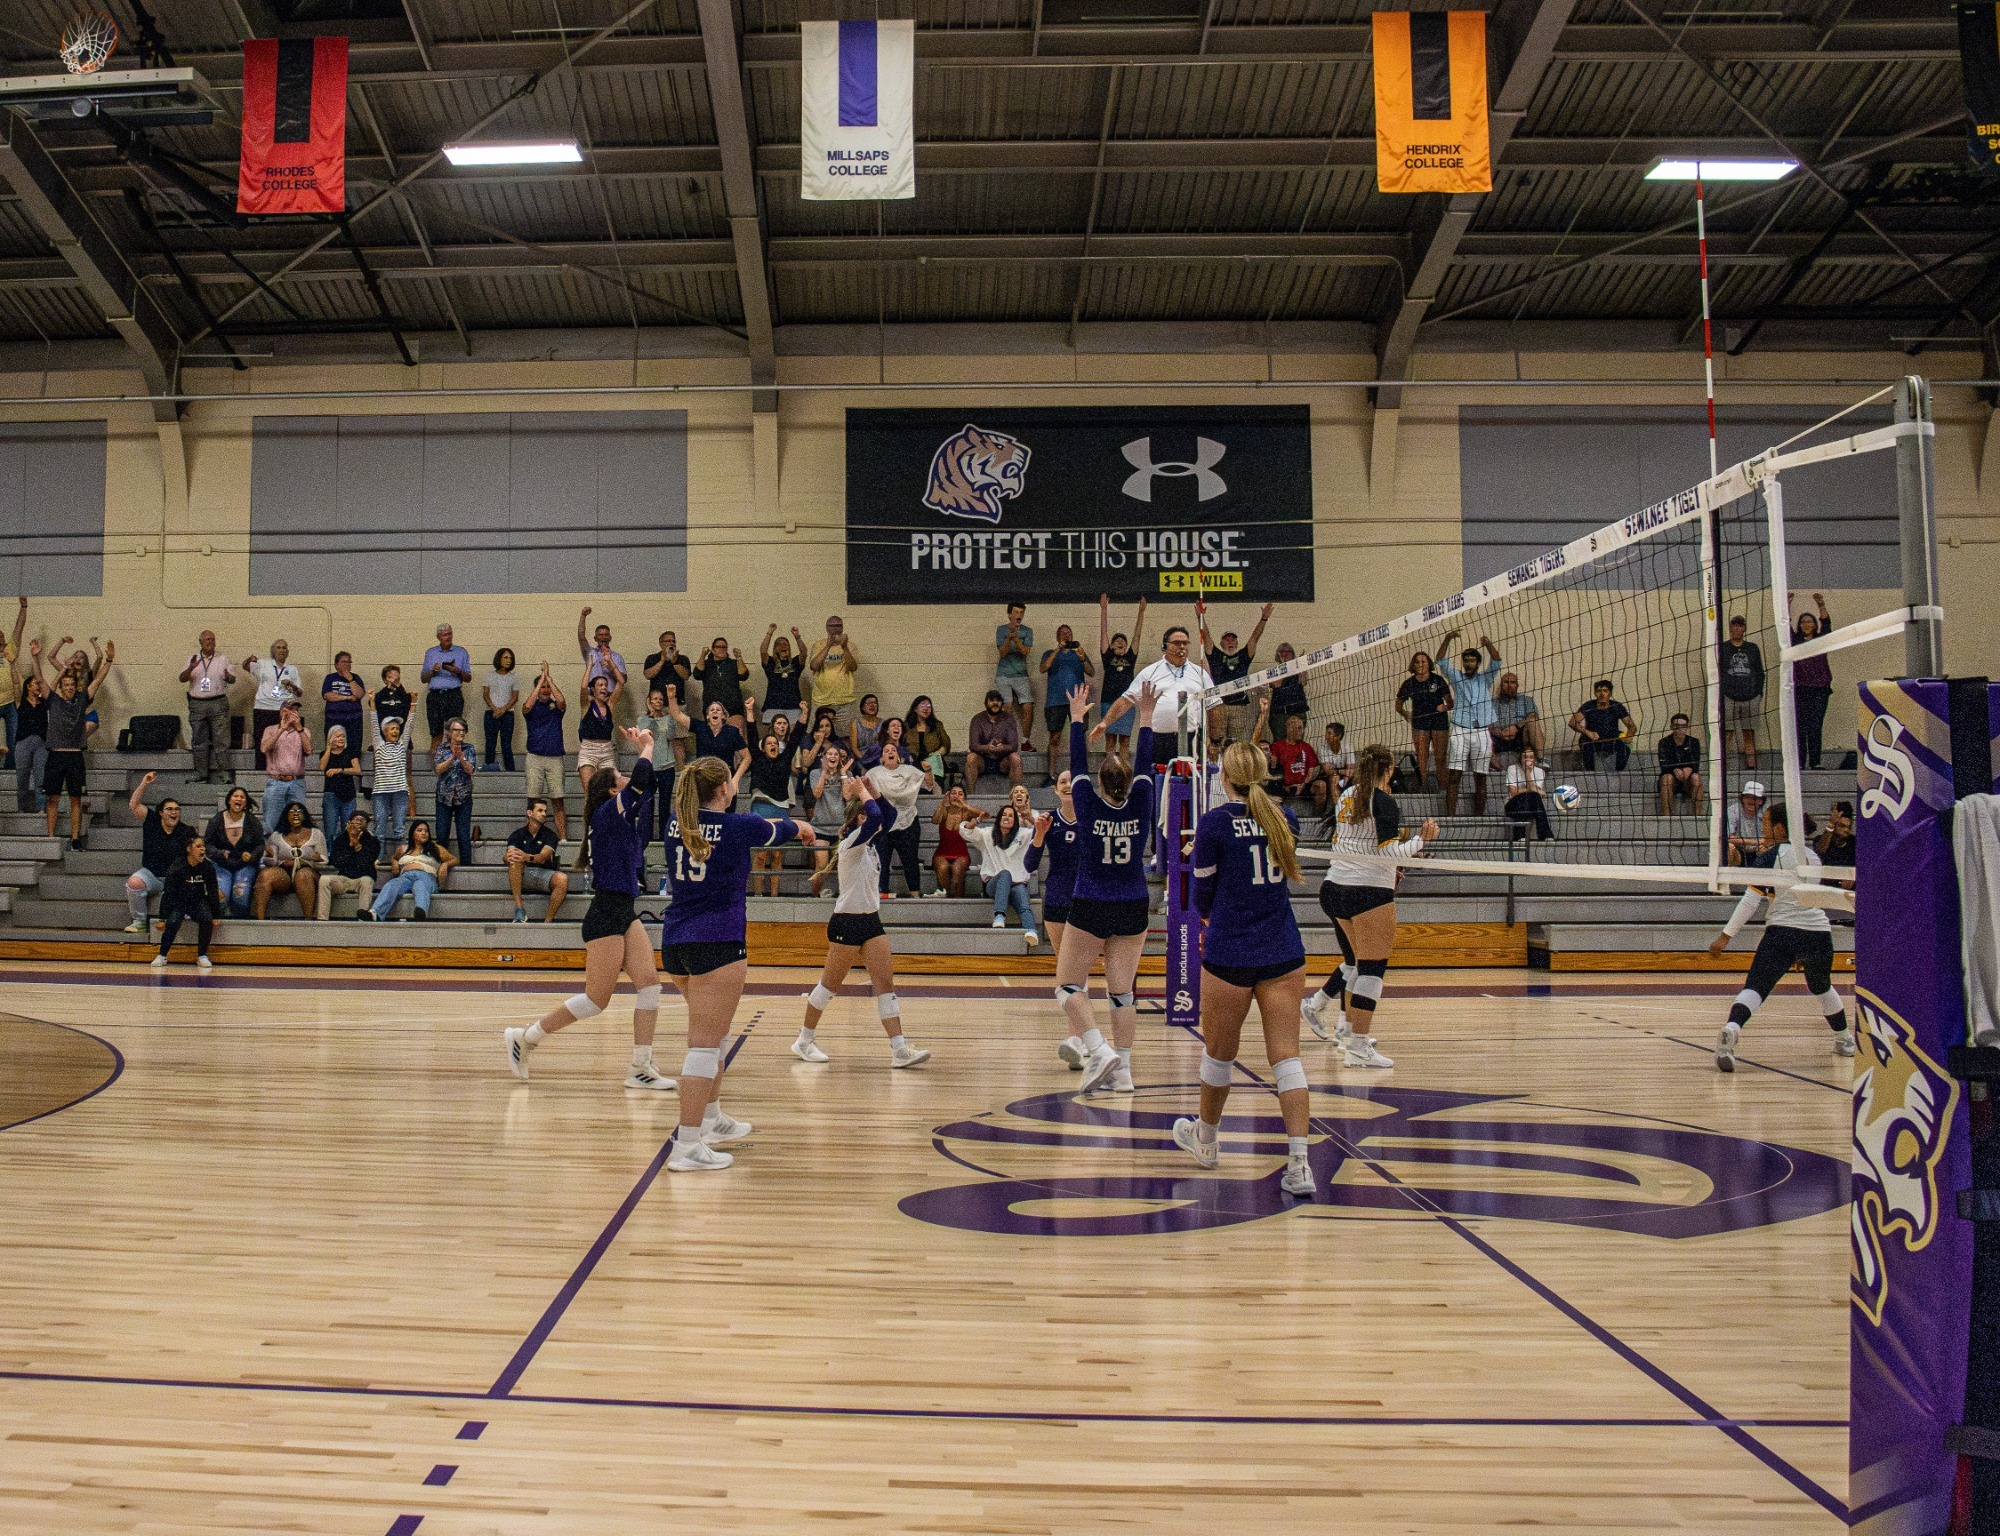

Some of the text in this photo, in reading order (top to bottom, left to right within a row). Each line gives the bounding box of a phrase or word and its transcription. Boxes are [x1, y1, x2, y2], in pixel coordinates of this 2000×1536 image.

[827, 150, 890, 161] MILLSAPS
[1406, 144, 1462, 155] HENDRIX
[828, 165, 888, 176] COLLEGE
[1405, 158, 1464, 169] COLLEGE
[265, 166, 315, 177] RHODES
[262, 179, 318, 191] COLLEGE
[1625, 500, 1669, 538] SEWANEE
[911, 531, 1250, 569] PROTECT THIS HOUSE.
[1508, 548, 1565, 587] SEWANEE TIGERS
[1189, 575, 1194, 588] I
[668, 820, 722, 841] SENEE
[1092, 819, 1140, 837] SEWANEE
[1102, 836, 1131, 864] 13
[1179, 924, 1188, 985] sports imports
